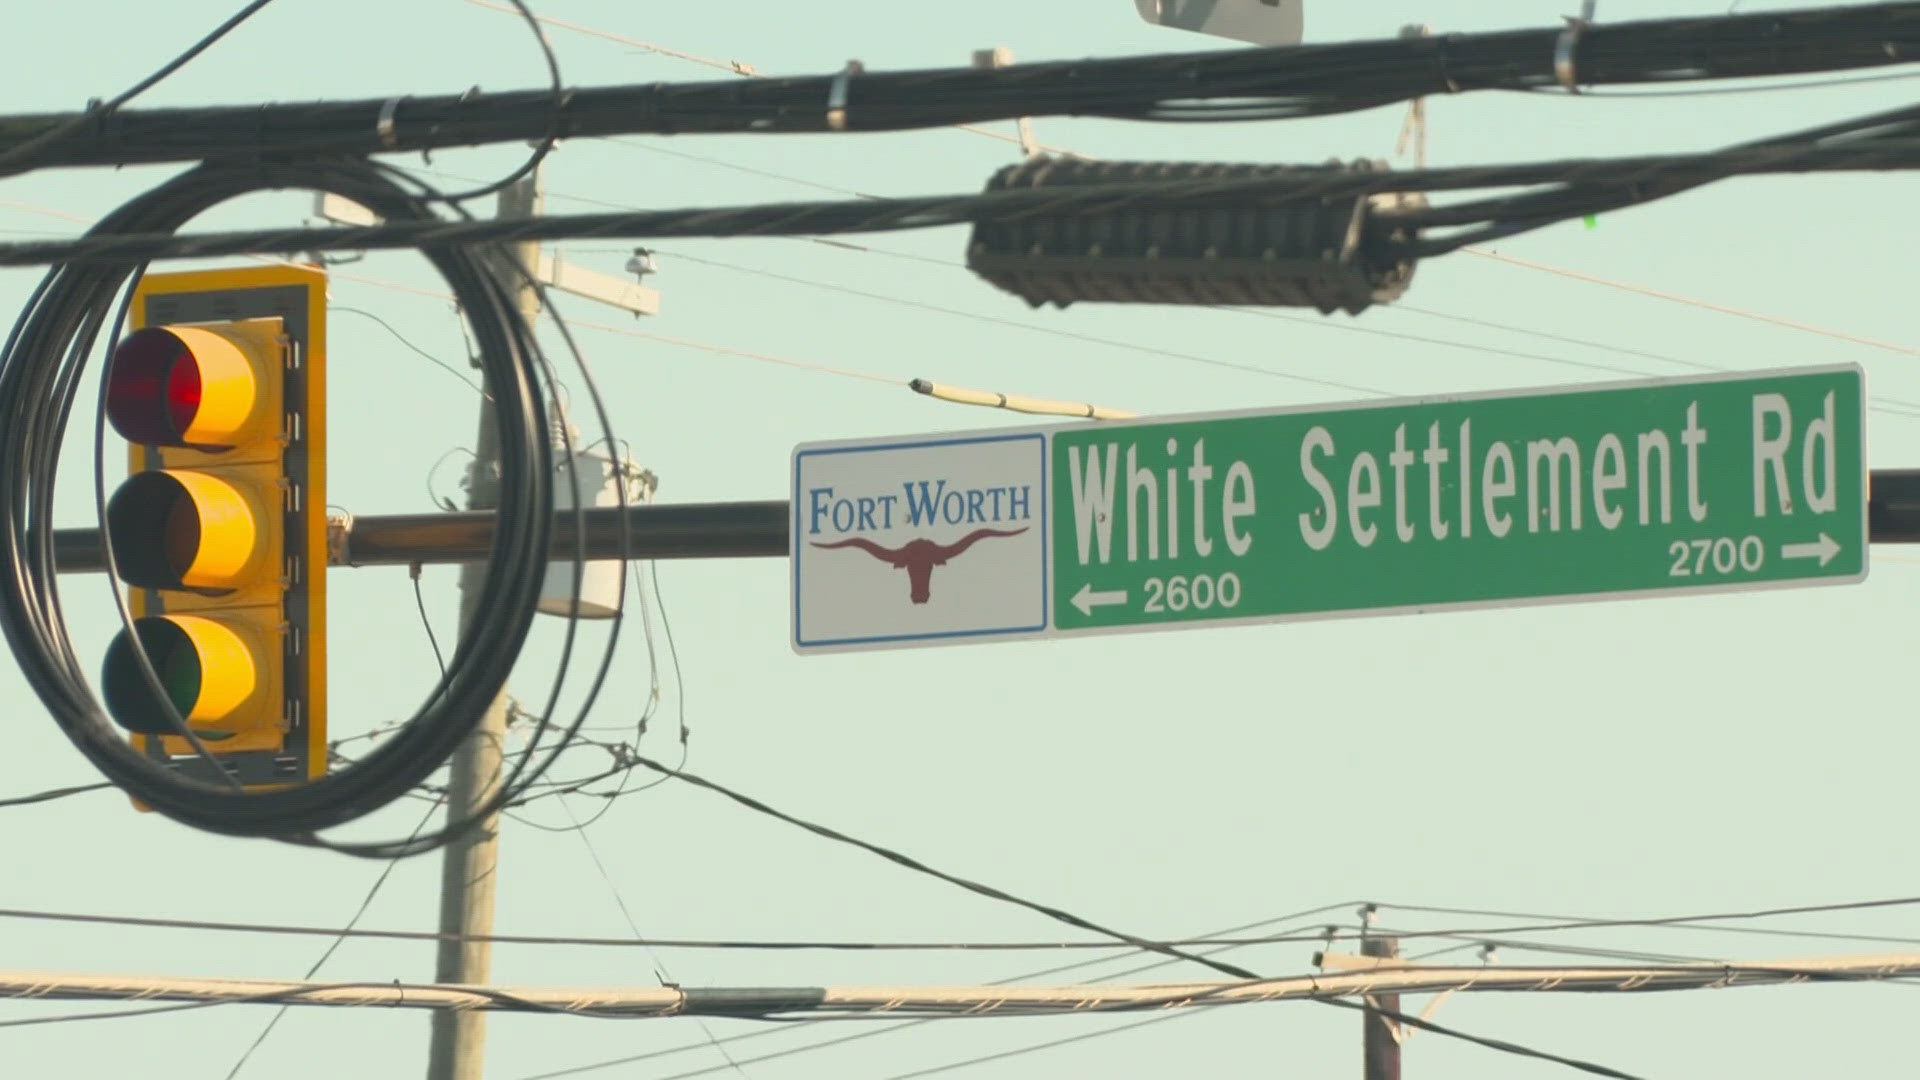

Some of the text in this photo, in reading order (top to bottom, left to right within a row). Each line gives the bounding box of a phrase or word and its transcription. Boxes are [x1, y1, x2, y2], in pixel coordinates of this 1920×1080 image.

[1068, 391, 1837, 565] White Settlement Rd
[809, 480, 1031, 534] FORT WORTH
[1669, 535, 1765, 577] 2700
[1144, 572, 1241, 613] 2600
